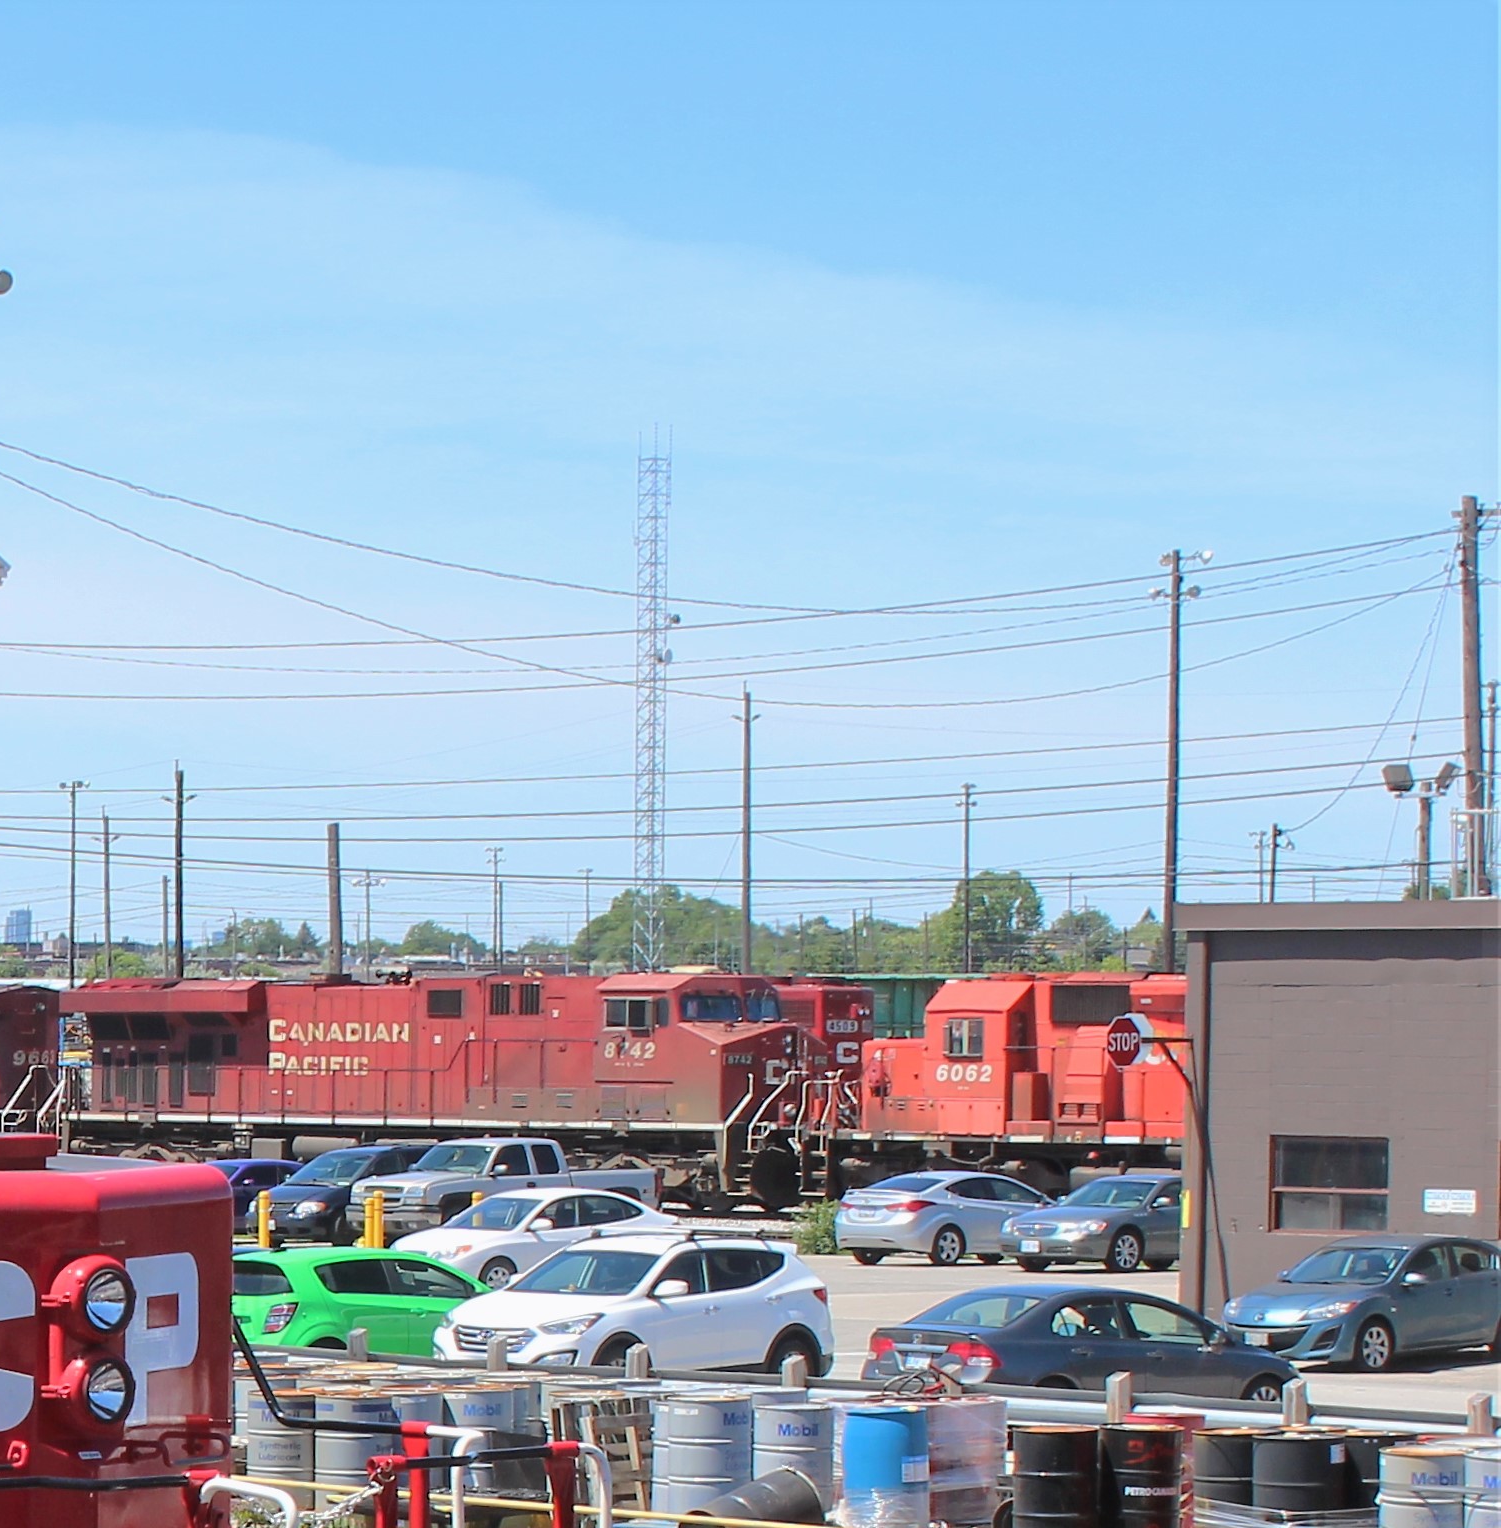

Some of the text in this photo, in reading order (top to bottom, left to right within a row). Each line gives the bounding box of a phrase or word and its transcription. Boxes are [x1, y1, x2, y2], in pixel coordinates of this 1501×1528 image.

[268, 1019, 410, 1043] CANADIAN
[604, 1041, 656, 1059] 8742
[1108, 1033, 1139, 1052] STOP
[268, 1051, 369, 1076] PACIFIC
[935, 1063, 993, 1083] 6062
[463, 1403, 501, 1417] Mobil
[777, 1423, 819, 1437] Mobil
[258, 1440, 301, 1452] Synthetic
[258, 1453, 301, 1462] Lubricant
[1411, 1471, 1459, 1487] Mobil
